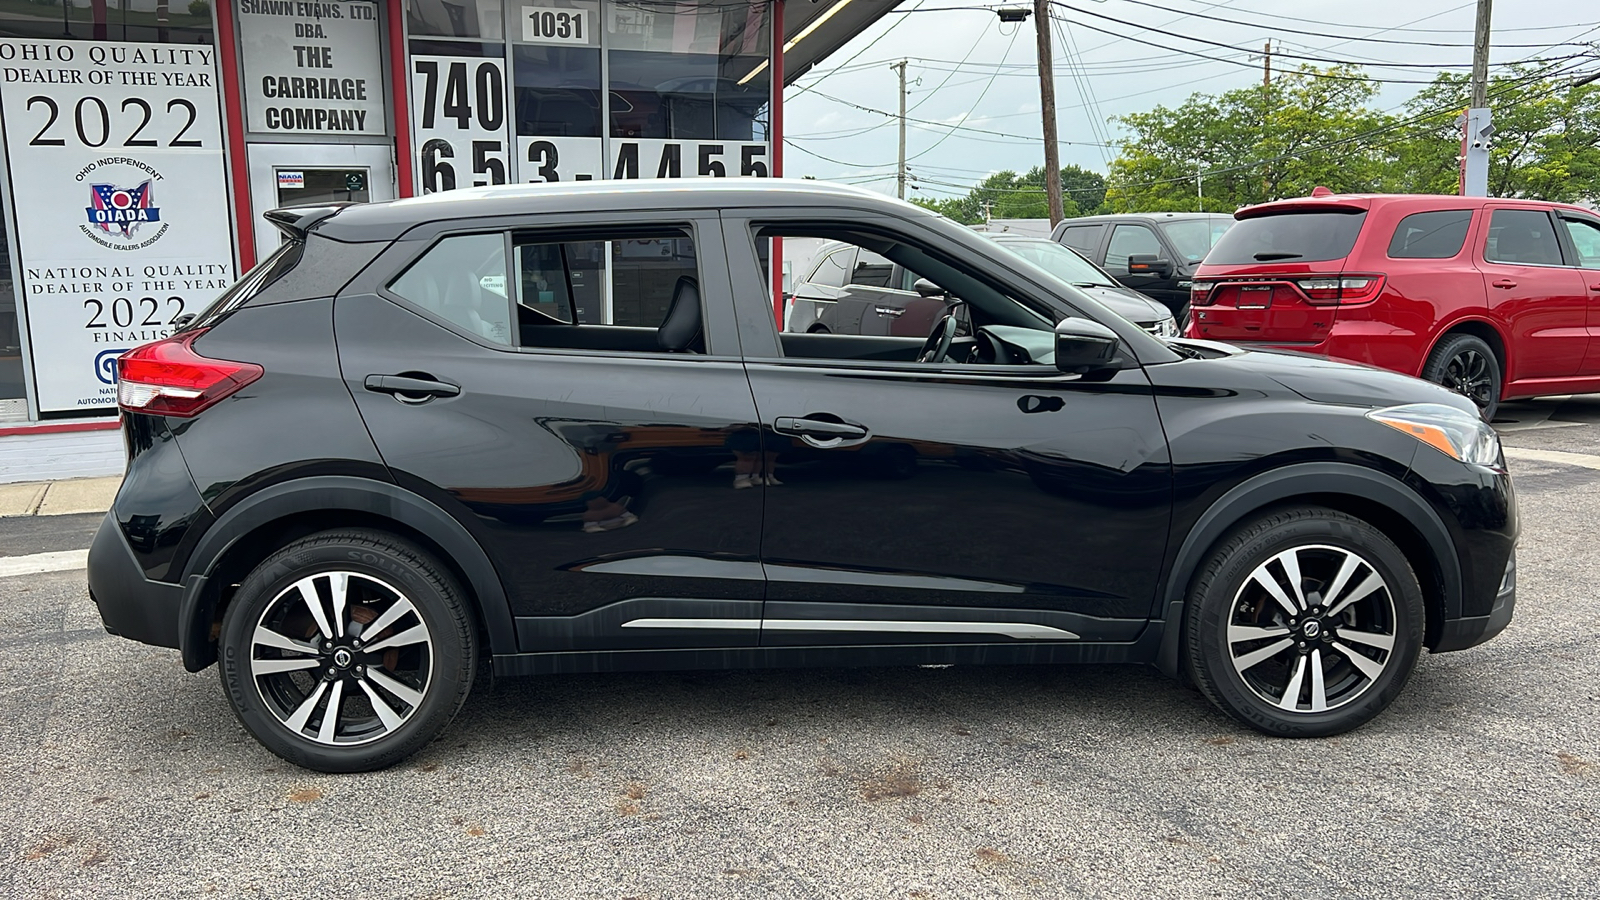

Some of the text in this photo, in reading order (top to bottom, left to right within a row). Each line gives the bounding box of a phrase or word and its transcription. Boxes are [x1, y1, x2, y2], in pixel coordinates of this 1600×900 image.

[241, 0, 376, 21] SHAWN EVANS. LTD.
[295, 23, 327, 39] DBA.
[528, 11, 583, 39] 1031
[0, 43, 211, 66] OHIO QUALITY
[293, 46, 333, 68] THE
[3, 67, 211, 87] DEALER OF THE YEAR
[262, 76, 367, 100] CARRIAGE
[415, 61, 503, 131] 740
[27, 95, 202, 148] 2022
[266, 107, 367, 131] COMPANY
[75, 157, 164, 182] OHIO INDEPENDENT
[95, 209, 148, 222] OIADA
[79, 222, 169, 251] AUTOMOBILE DEALERS ASSOCIATION
[28, 264, 228, 280] NATIONAL QUALITY
[32, 279, 227, 295] DEALER OF THE YEAR
[83, 296, 187, 329] 2022
[77, 397, 116, 405] AUTOMOB
[99, 387, 116, 395] NATI
[347, 551, 416, 583] SOLUS
